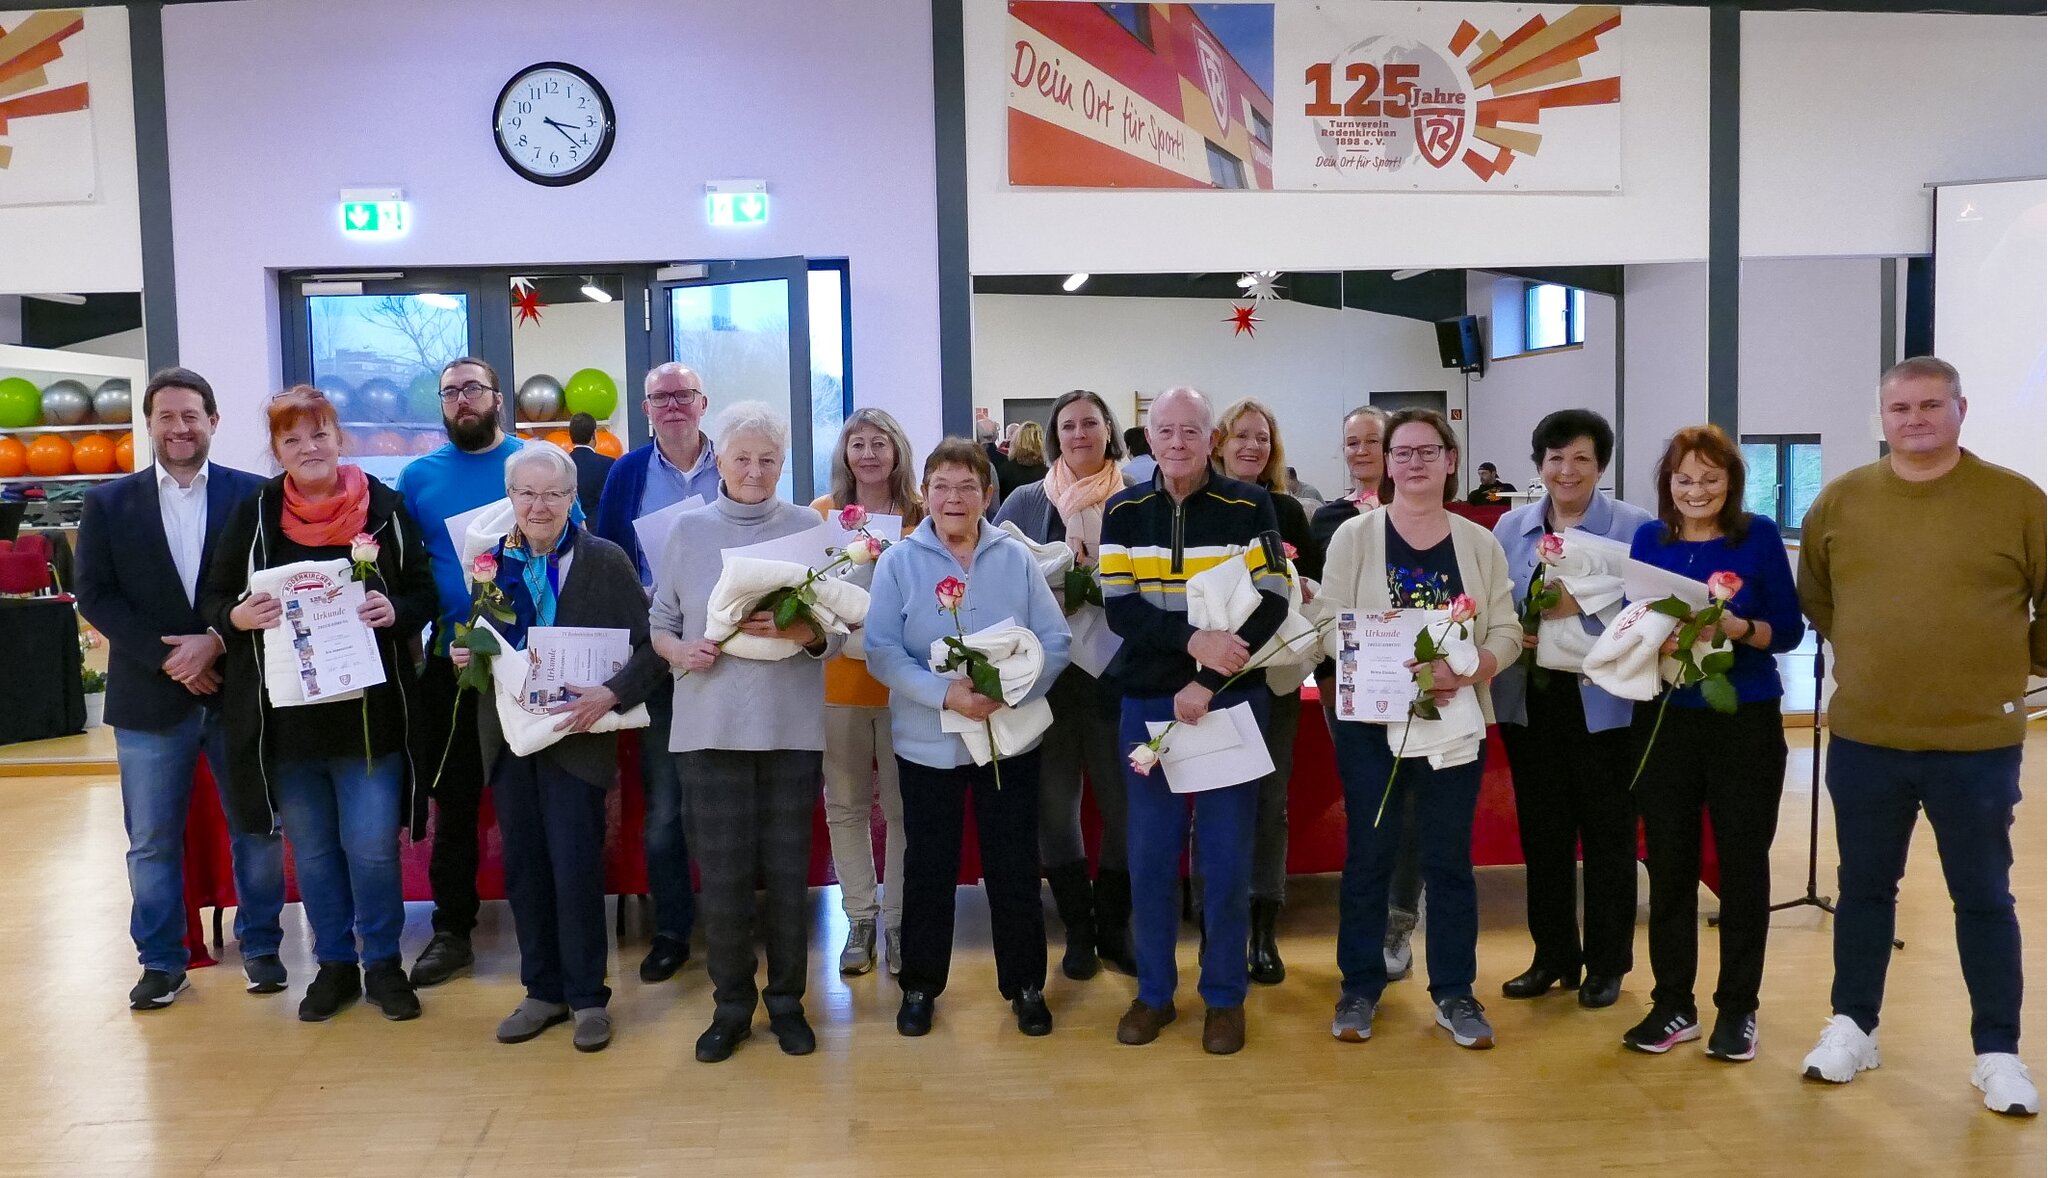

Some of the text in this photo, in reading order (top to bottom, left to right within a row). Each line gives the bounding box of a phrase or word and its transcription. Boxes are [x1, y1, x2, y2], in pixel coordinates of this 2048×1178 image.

[530, 88, 541, 99] 11
[545, 82, 559, 94] 12
[567, 86, 571, 98] 1
[1305, 63, 1420, 118] 125
[577, 97, 586, 109] 2
[1011, 40, 1185, 163] Dein Ort für Sport!
[1411, 88, 1466, 107] Jahre
[518, 101, 532, 114] 10
[512, 117, 521, 129] 9
[586, 115, 594, 127] 3
[1329, 120, 1389, 128] Turnverein
[579, 132, 588, 144] 4
[1321, 129, 1397, 137] Rodenkirchen
[518, 134, 528, 147] 8
[534, 147, 541, 158] 7
[549, 152, 559, 163] 6
[569, 146, 577, 158] 5
[1315, 155, 1403, 171] Dein Ort für Sport!
[313, 608, 346, 620] Urkunde
[1365, 629, 1400, 638] Urkunde
[547, 648, 556, 681] Urkunde
